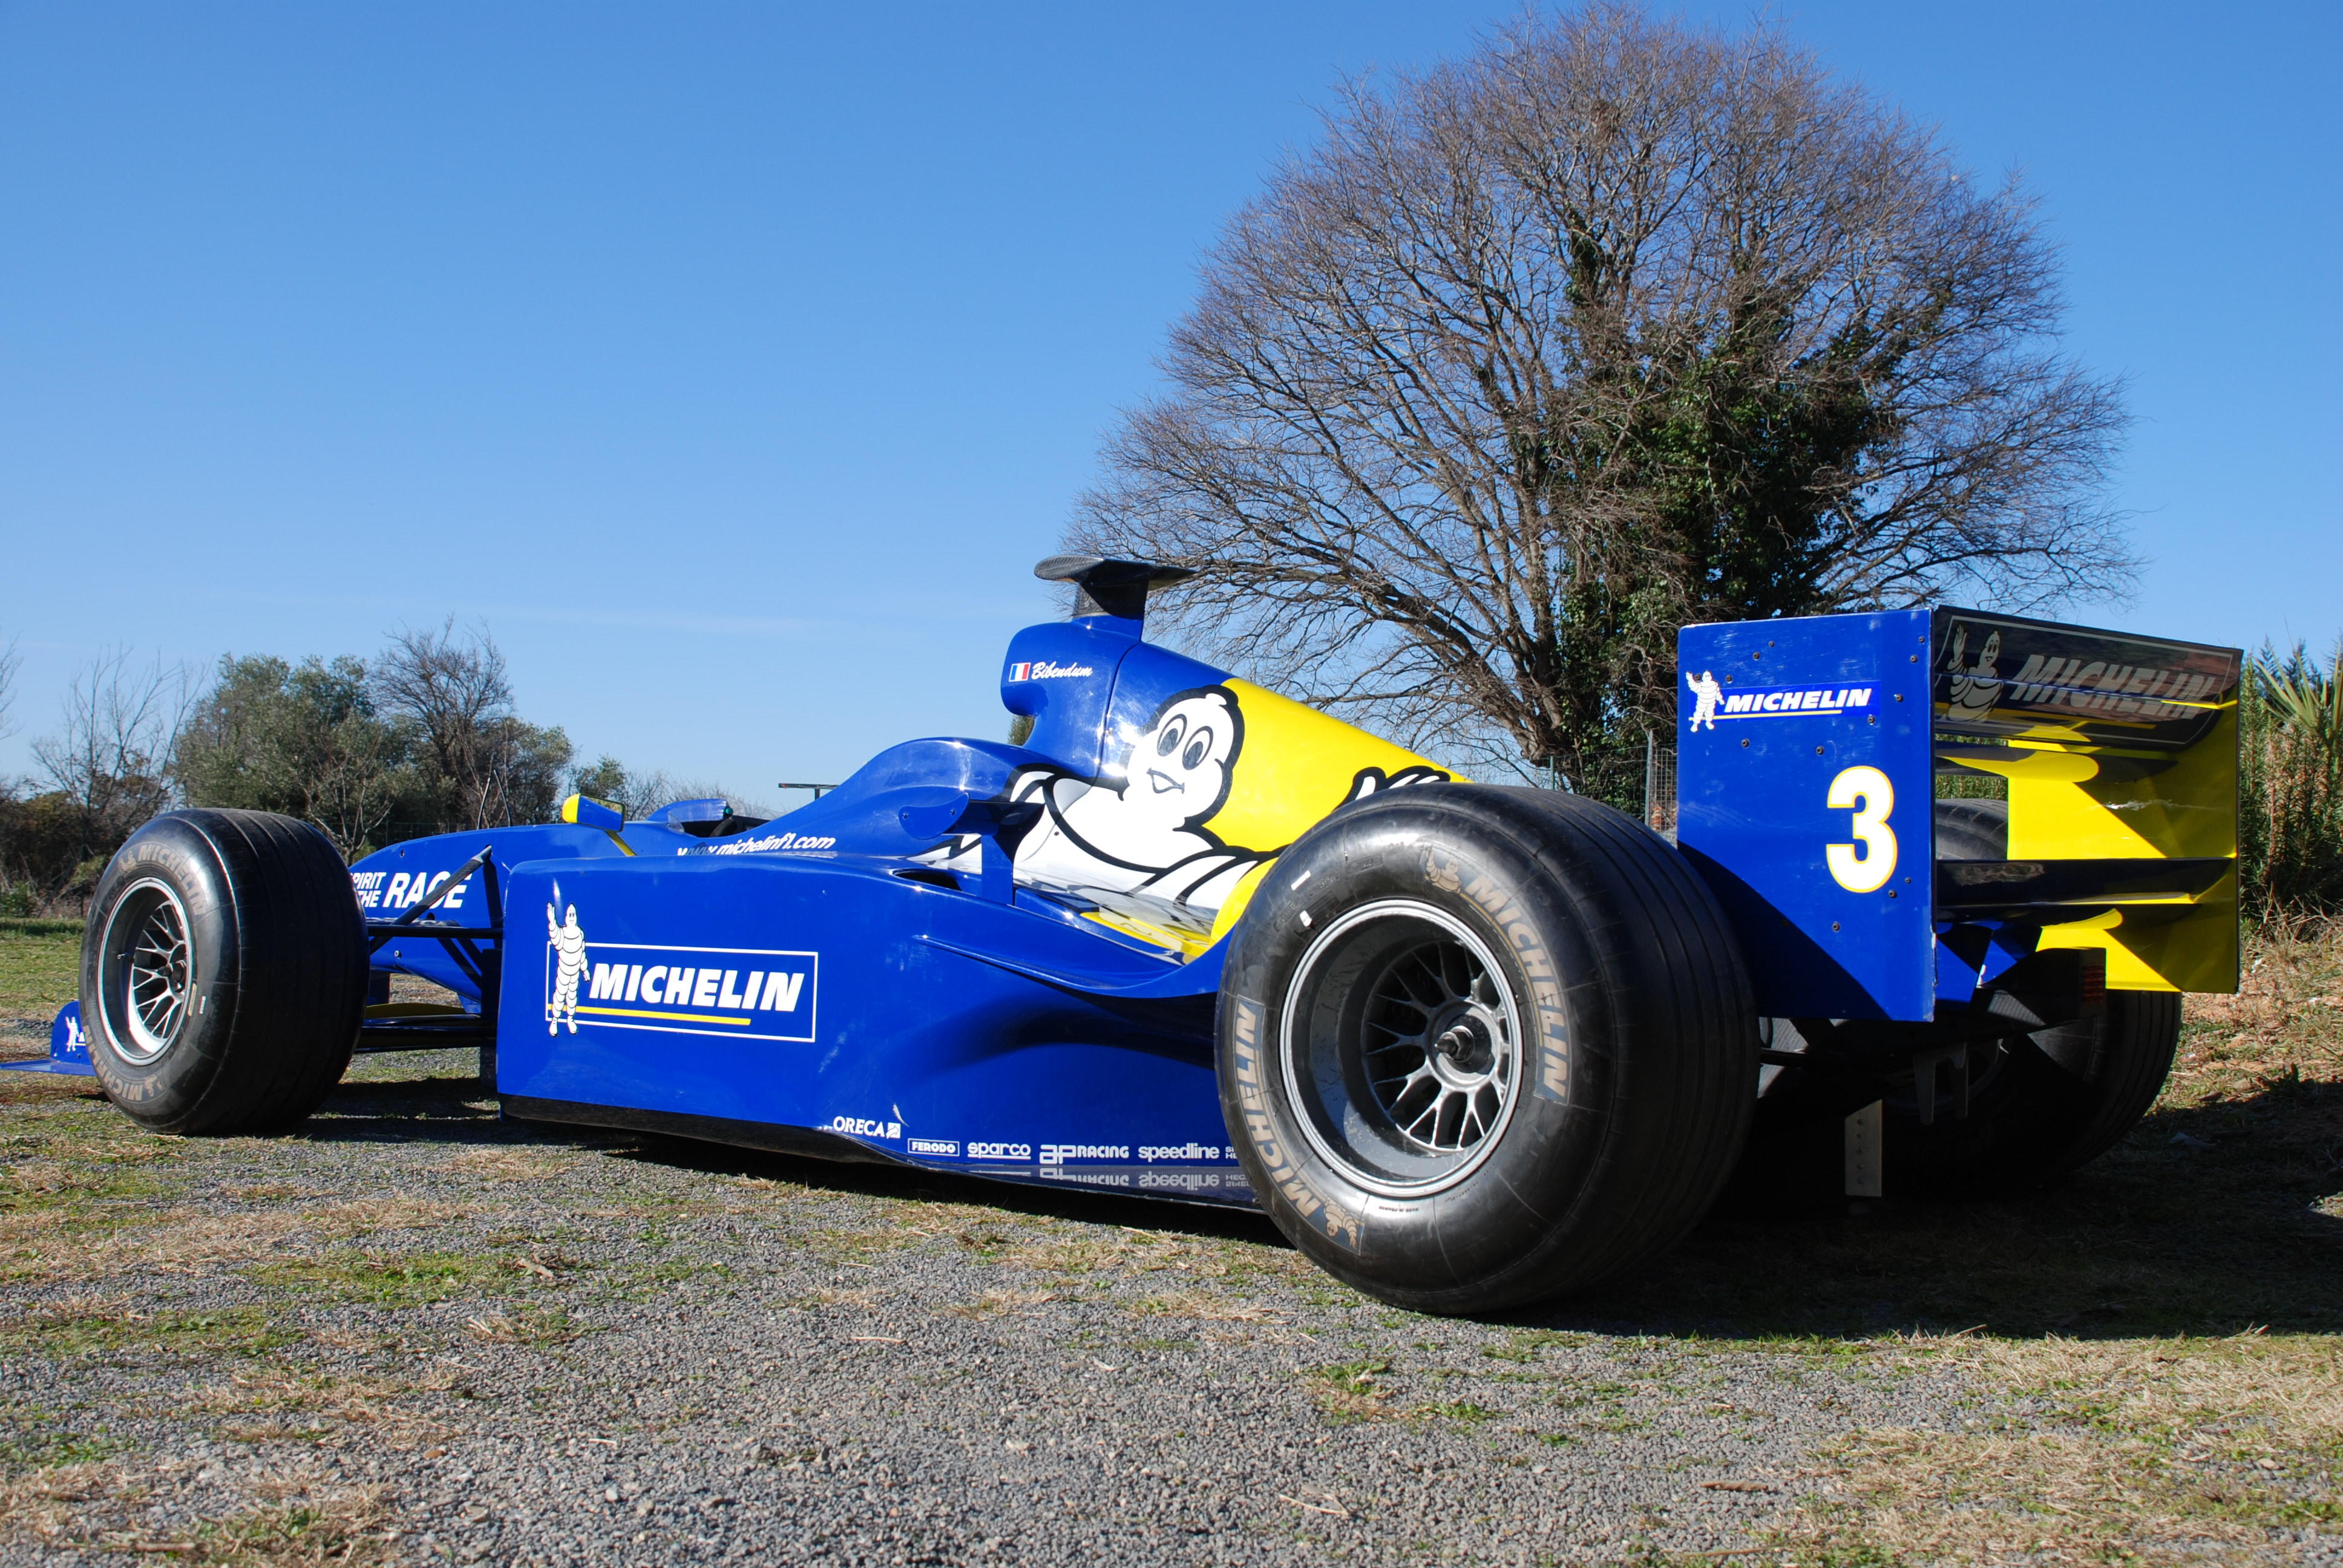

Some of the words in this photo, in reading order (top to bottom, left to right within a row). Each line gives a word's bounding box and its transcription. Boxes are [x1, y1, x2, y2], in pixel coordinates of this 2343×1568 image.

[1031, 661, 1093, 680] Bibendum
[2010, 655, 2216, 720] MICHELIN
[1724, 688, 1872, 713] MICHELIN
[1826, 765, 1898, 893] 3
[677, 832, 836, 855] wwwmichelinf1.com
[137, 844, 206, 915] MICHELIN
[350, 872, 387, 889] PIRIT
[382, 871, 472, 909] RACE
[589, 962, 805, 1011] MICHELIN
[1464, 875, 1569, 1097] MICHELIN
[1236, 1003, 1321, 1217] MICHELIN
[833, 1116, 885, 1137] ORECA
[912, 1141, 956, 1154] FERODO
[968, 1142, 1031, 1158] sparco
[1077, 1145, 1129, 1158] RACING
[1138, 1143, 1220, 1163] speedline
